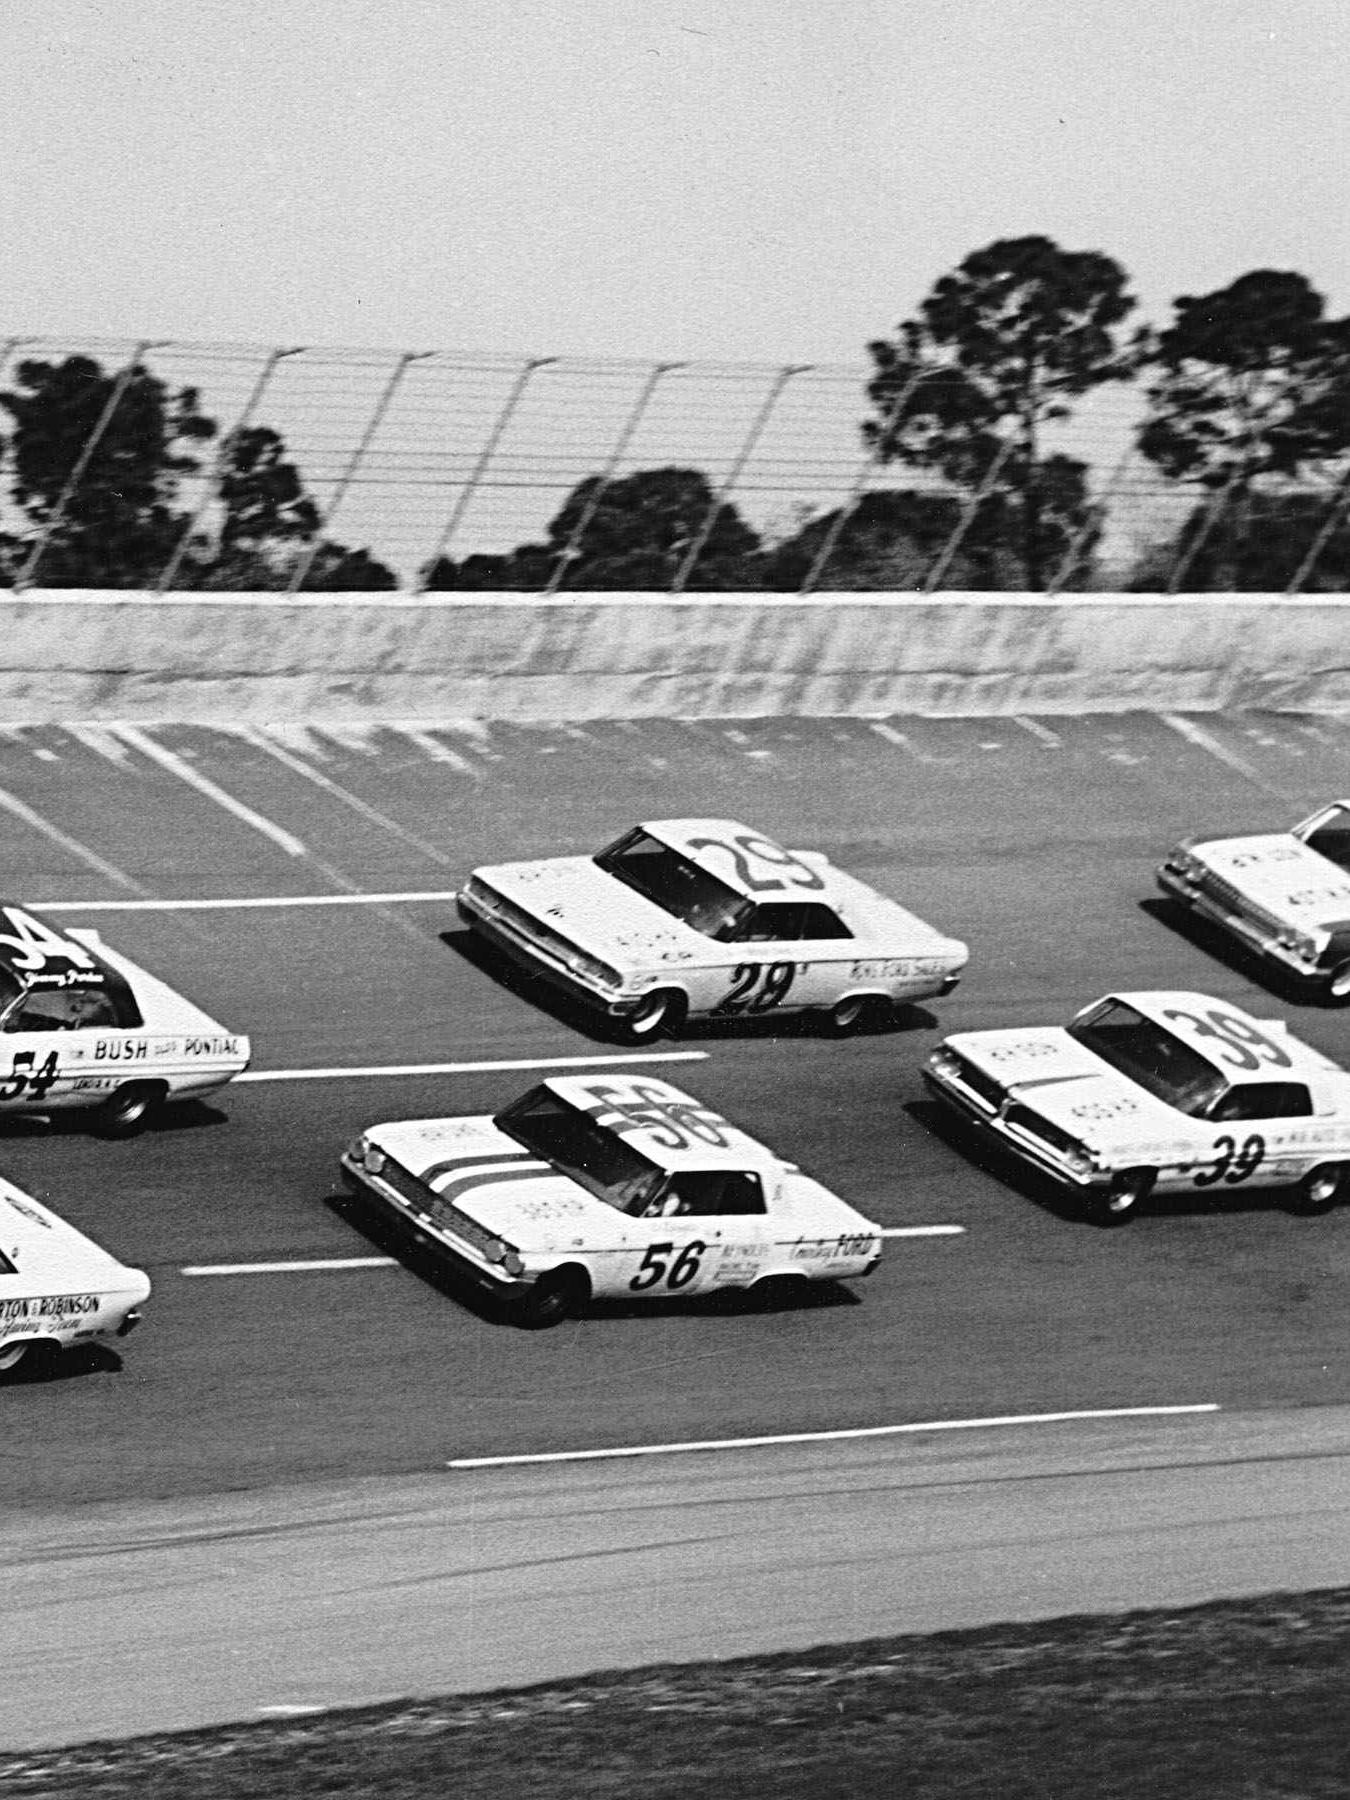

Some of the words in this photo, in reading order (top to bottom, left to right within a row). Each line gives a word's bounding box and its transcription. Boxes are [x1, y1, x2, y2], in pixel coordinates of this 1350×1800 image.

[686, 836, 825, 891] 29
[710, 962, 796, 1016] 29
[95, 1040, 148, 1060] BUSH
[185, 1038, 239, 1056] PONTIAC
[1163, 1010, 1292, 1070] 39
[1194, 1134, 1266, 1187] 39
[630, 1240, 707, 1291] 56
[38, 1296, 99, 1316] ROBINSON
